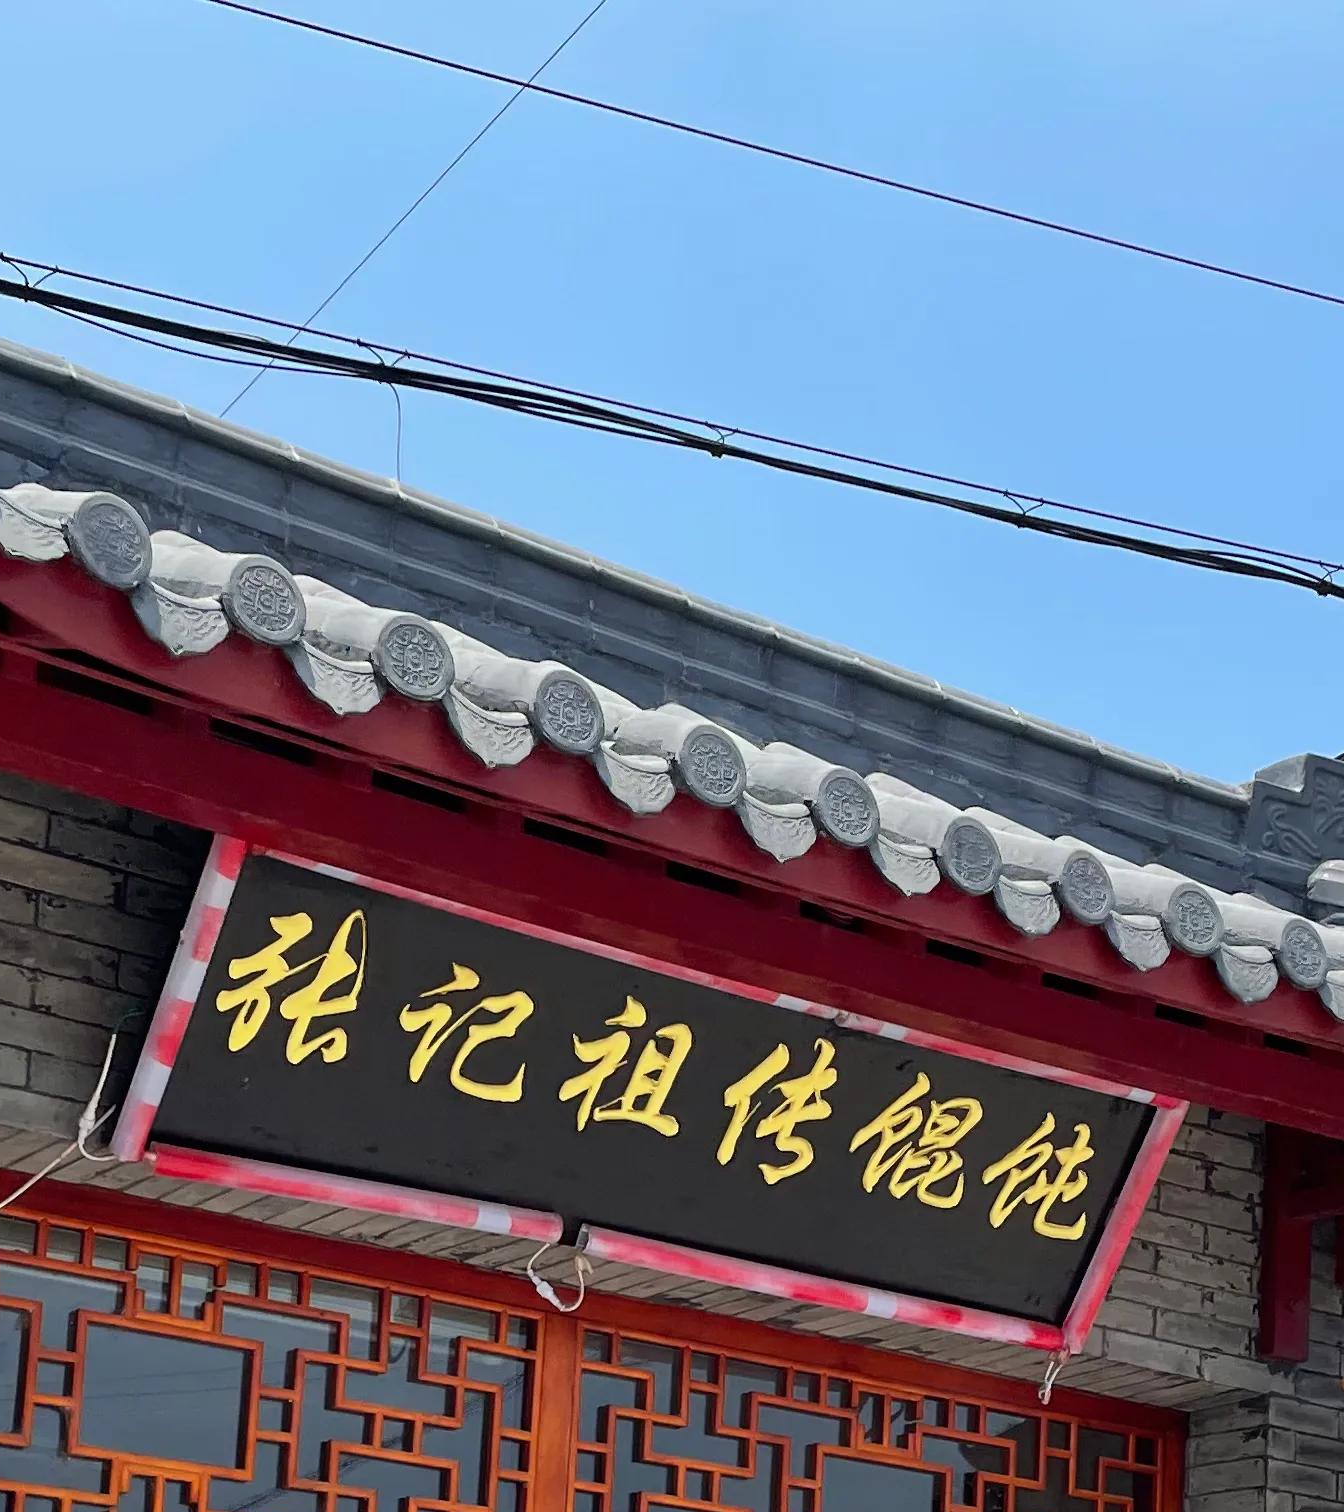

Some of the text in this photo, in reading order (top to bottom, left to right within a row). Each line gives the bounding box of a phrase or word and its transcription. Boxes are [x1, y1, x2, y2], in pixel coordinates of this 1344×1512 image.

[216, 908, 1093, 1241] 张记祖传馄饨
